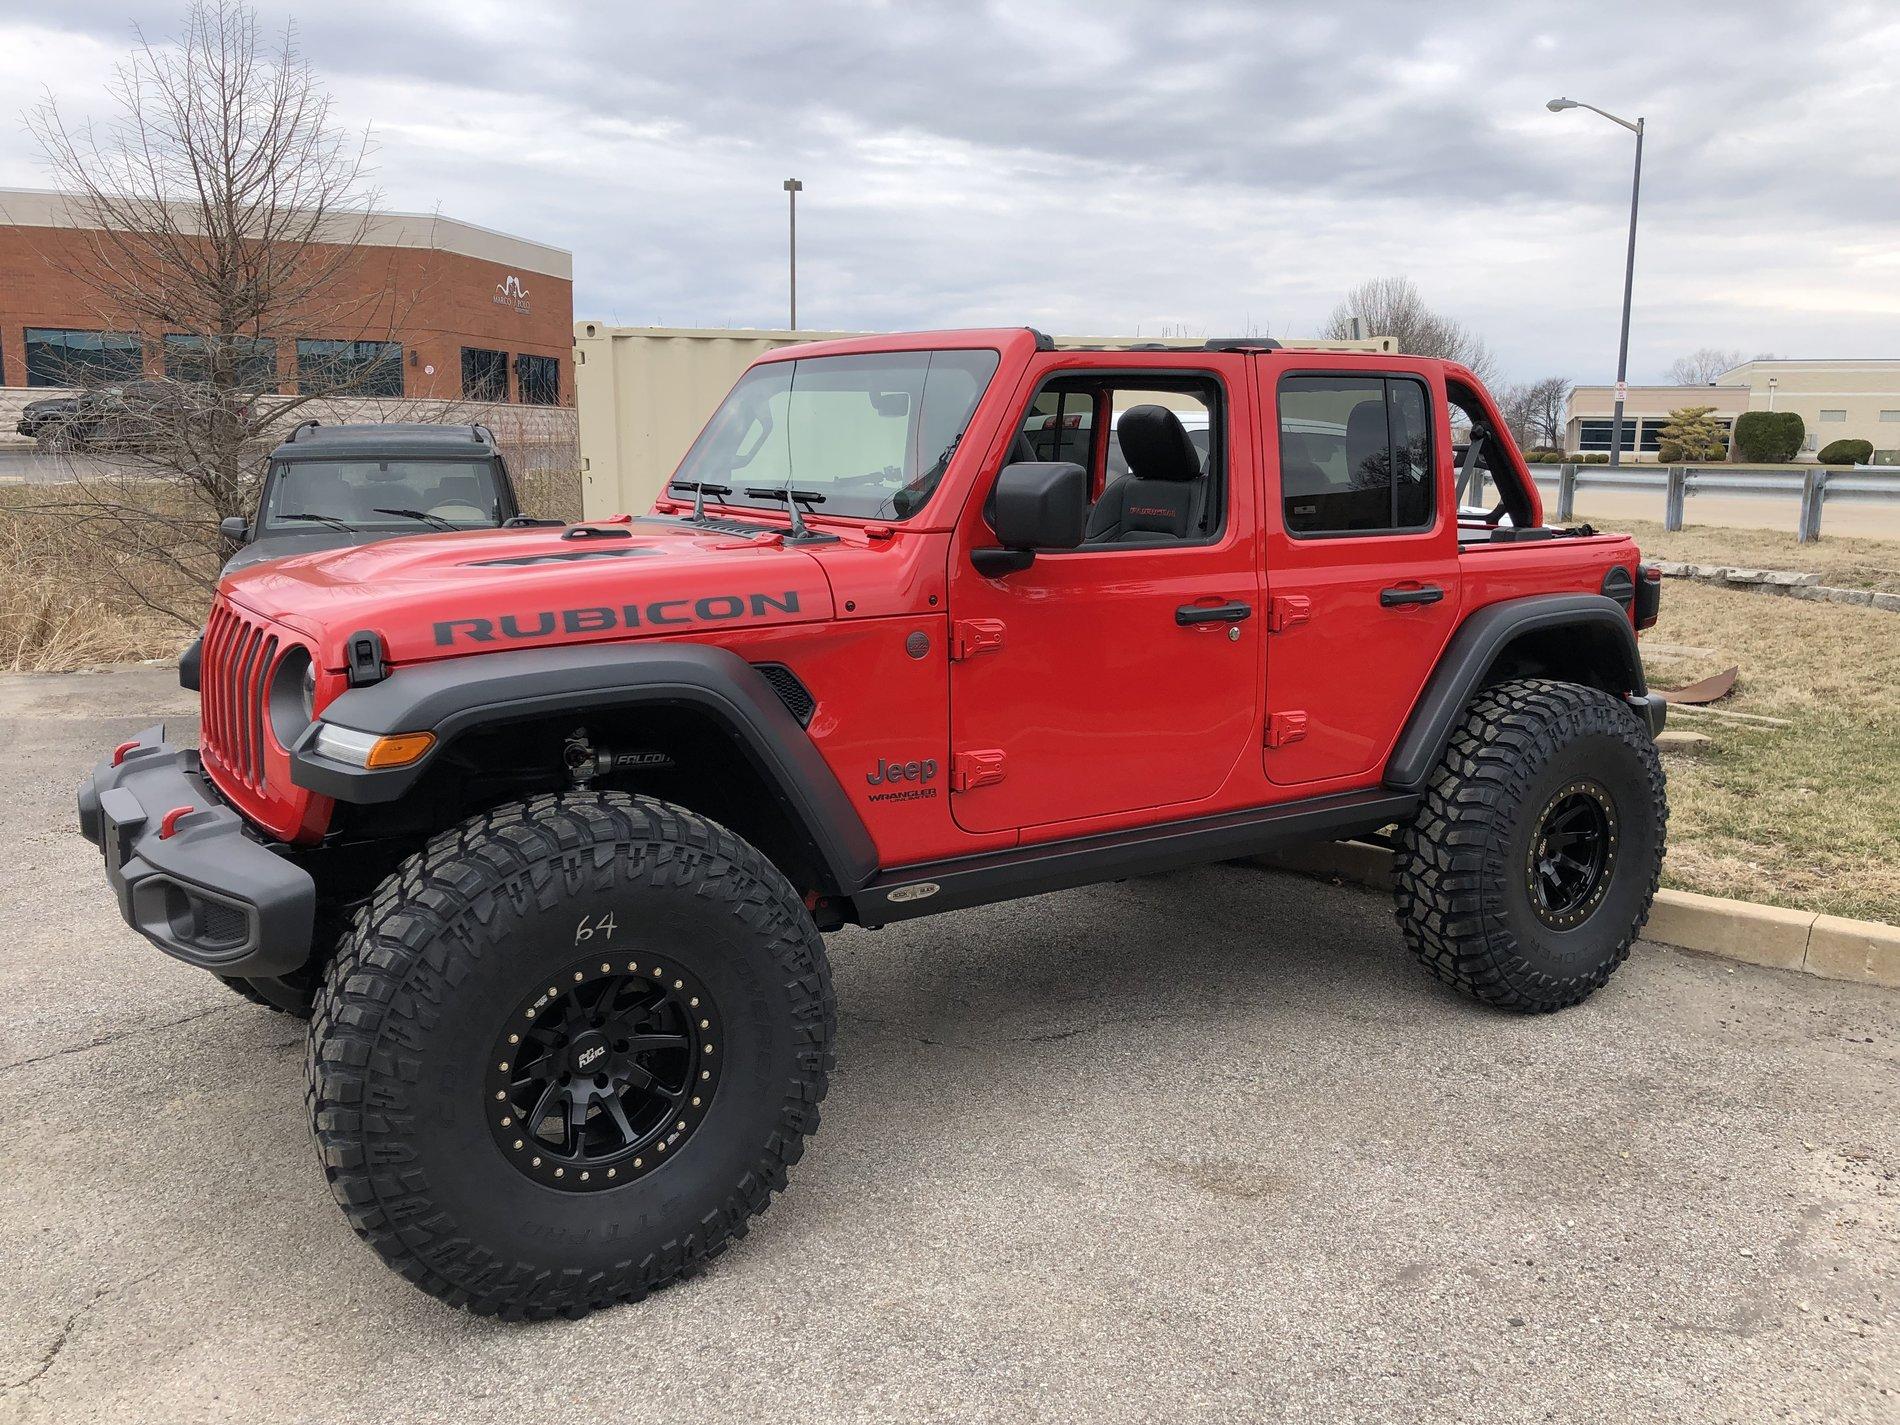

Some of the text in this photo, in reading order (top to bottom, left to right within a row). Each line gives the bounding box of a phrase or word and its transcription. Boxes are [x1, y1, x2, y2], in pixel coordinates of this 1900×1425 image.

[433, 591, 800, 646] RUBICON
[866, 758, 938, 785] Jeep
[868, 788, 937, 802] WRANGLER
[574, 910, 618, 946] 64
